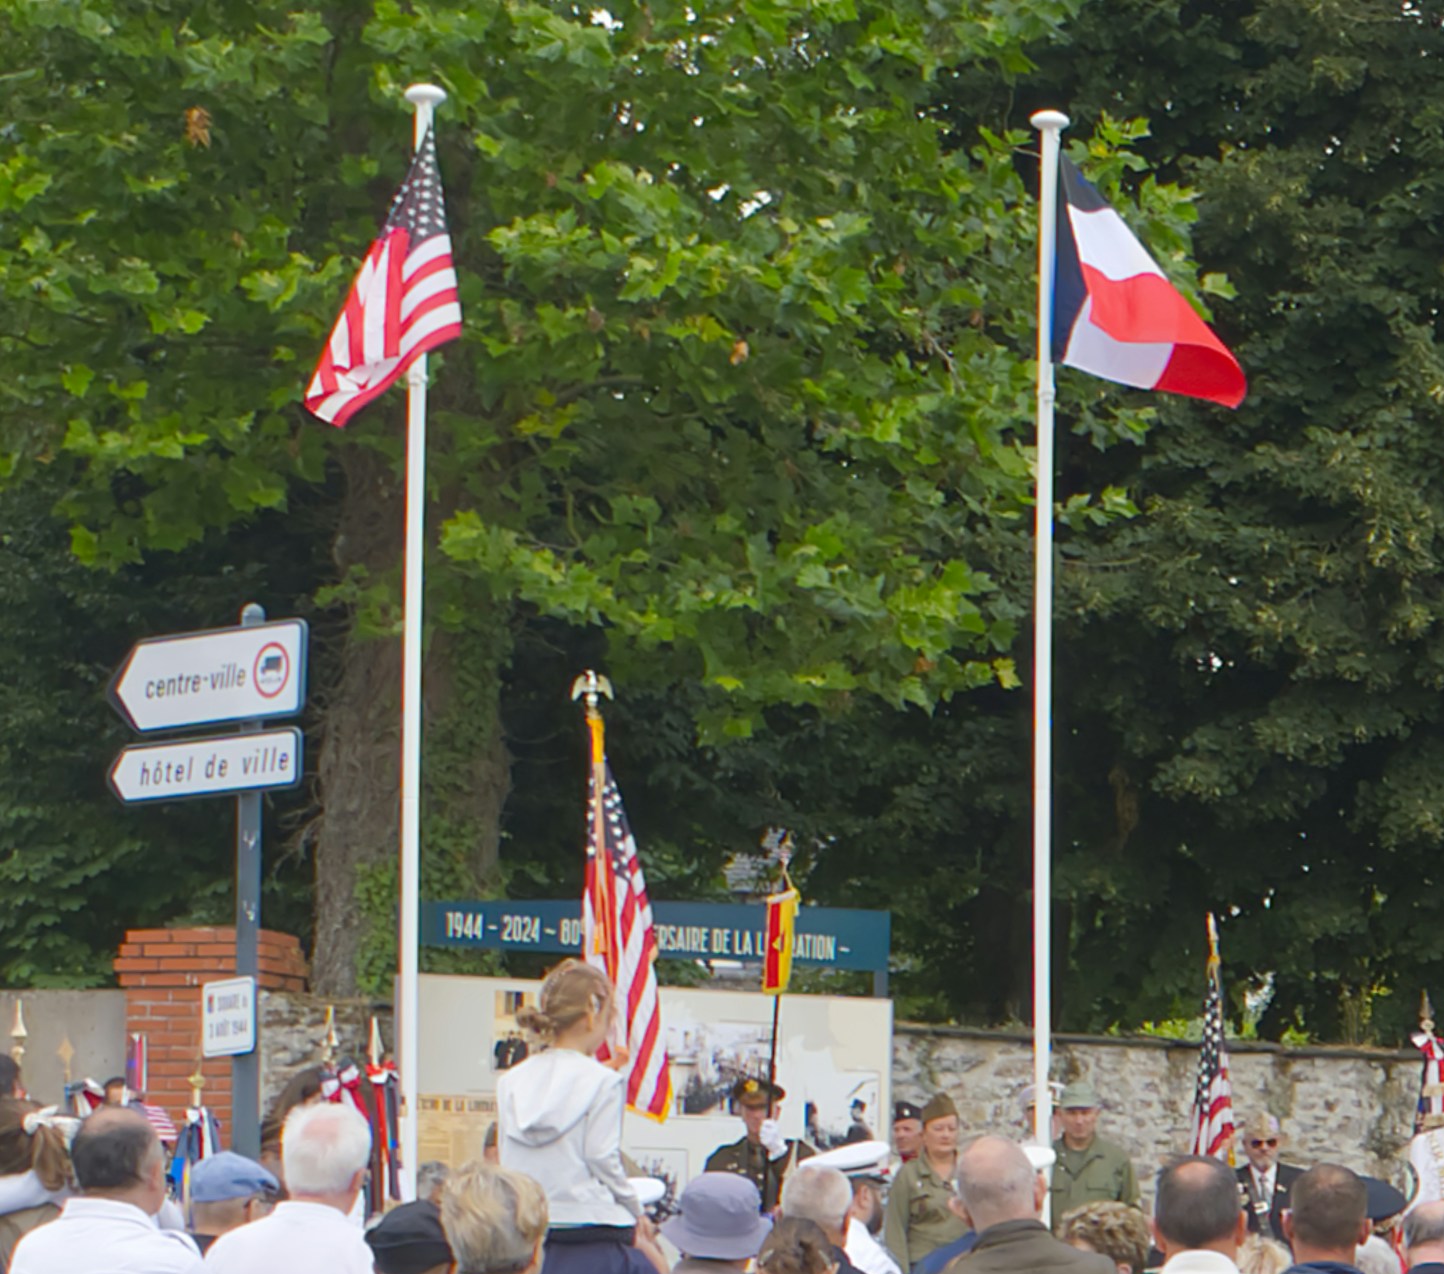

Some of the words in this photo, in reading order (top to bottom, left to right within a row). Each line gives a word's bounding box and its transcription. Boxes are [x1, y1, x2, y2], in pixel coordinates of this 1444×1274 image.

[145, 662, 247, 700] centre-ville
[139, 757, 194, 787] hôtel
[205, 752, 229, 779] de
[242, 747, 290, 775] ville
[445, 911, 484, 940] 1944
[502, 914, 541, 944] 2024
[712, 927, 731, 954] DE
[733, 929, 752, 956] LA
